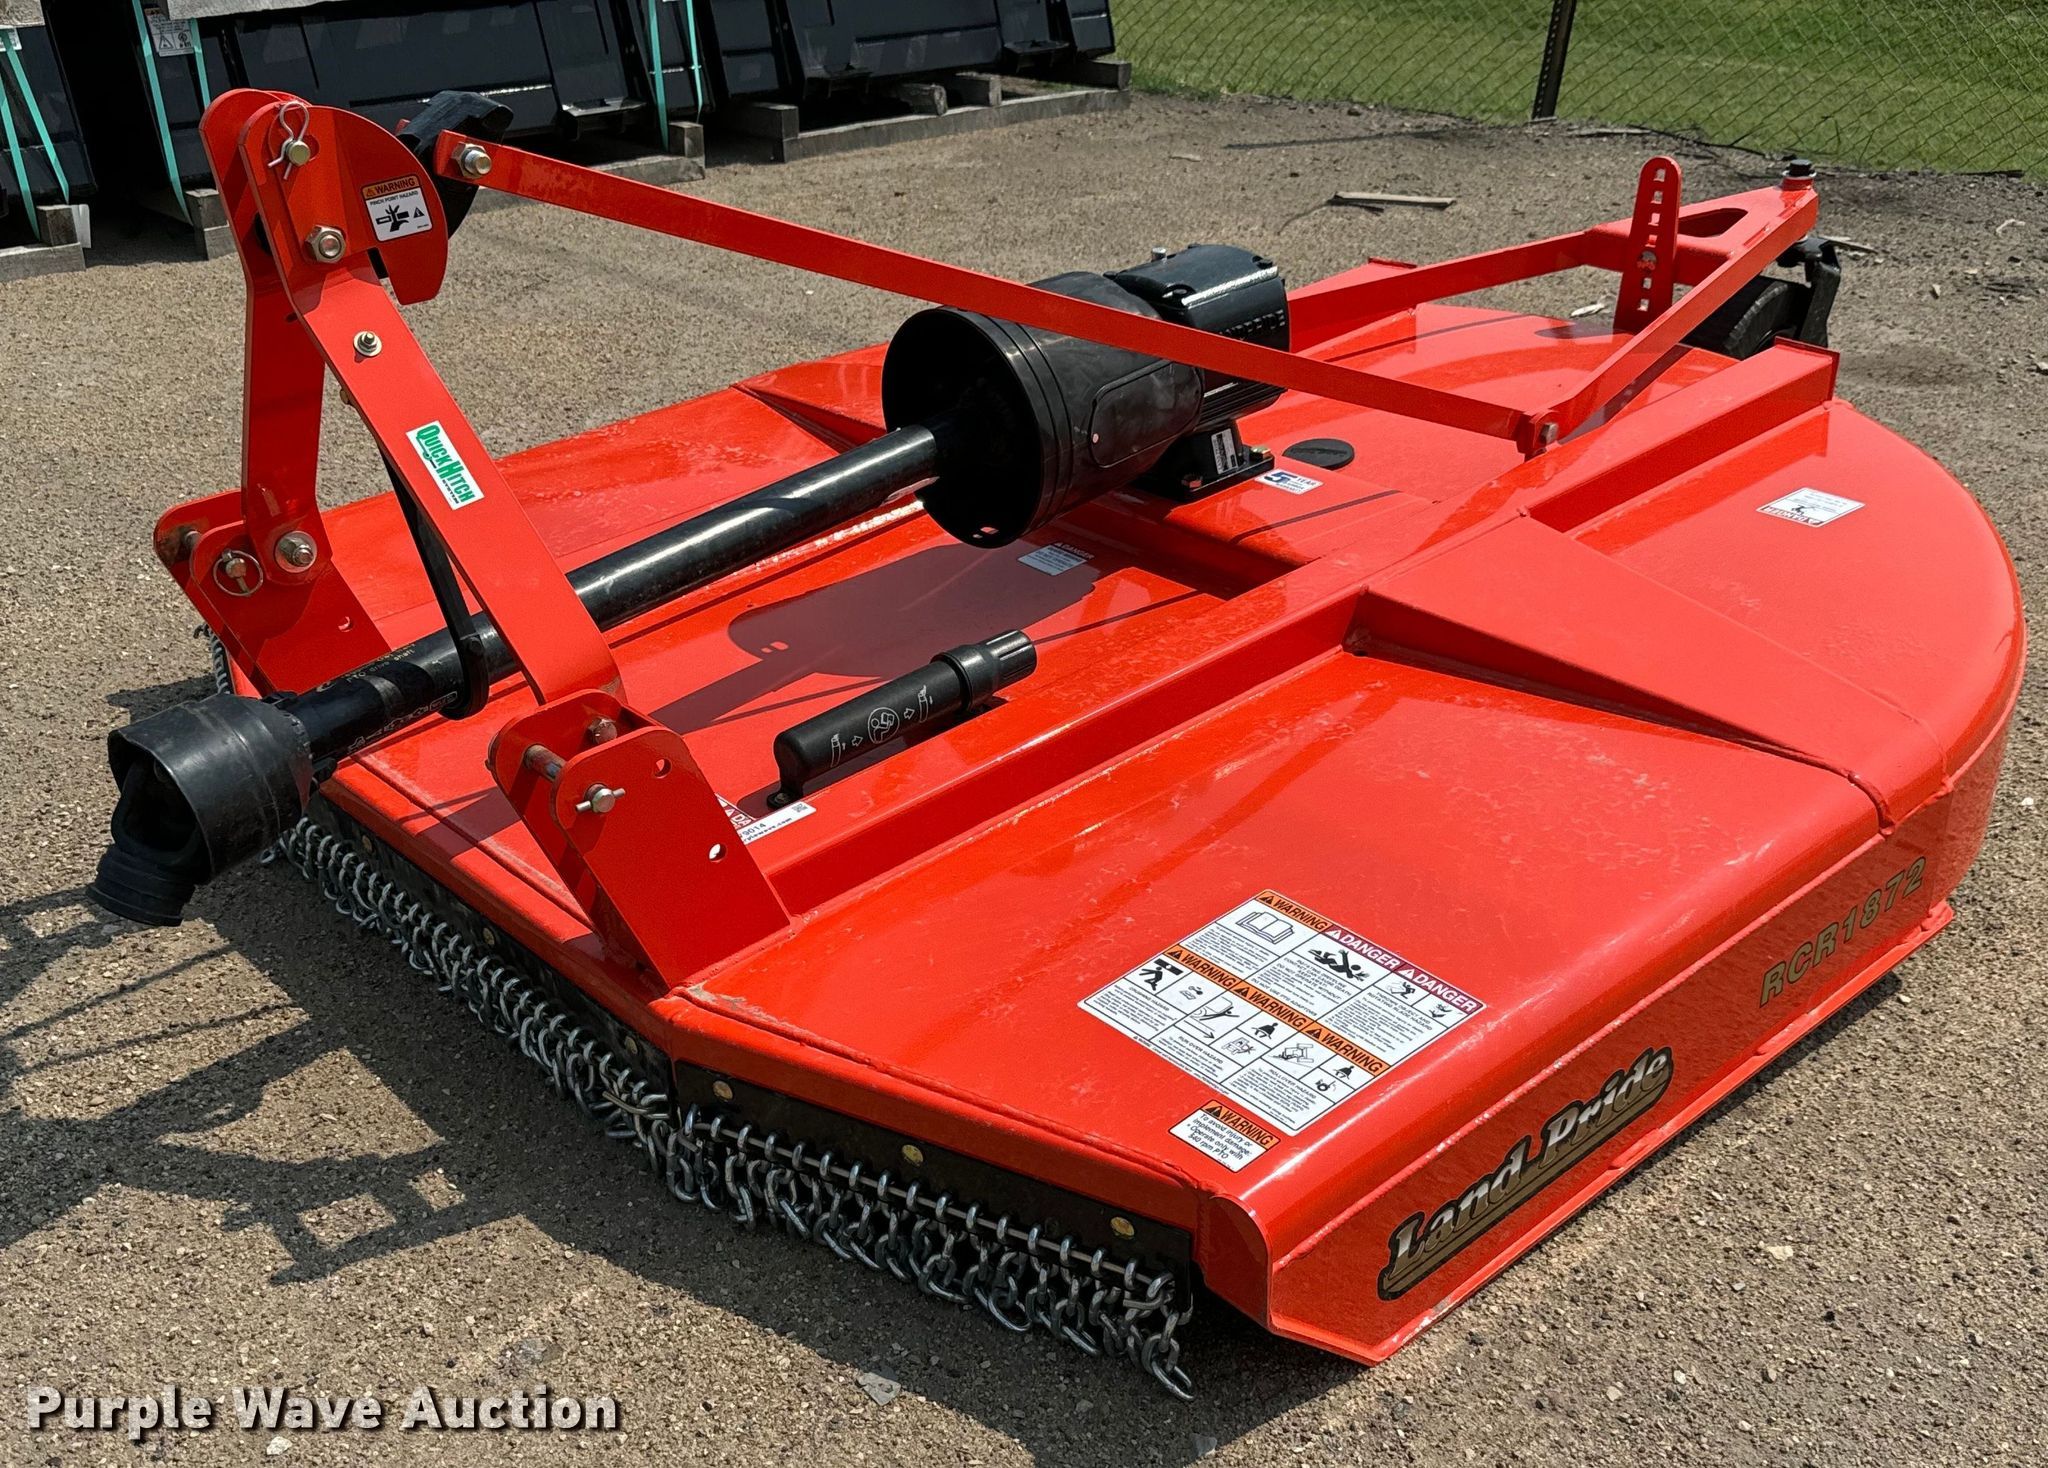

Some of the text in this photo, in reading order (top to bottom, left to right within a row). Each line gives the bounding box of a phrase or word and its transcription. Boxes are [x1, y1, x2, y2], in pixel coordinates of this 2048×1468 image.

[374, 177, 416, 195] WARNING
[1271, 899, 1329, 930] WARNING
[1759, 856, 1927, 1009] RCR1872
[1337, 934, 1401, 968] DANGER
[1179, 953, 1237, 987] WARNING
[1246, 991, 1308, 1027] WARNING
[1410, 973, 1479, 1011] DANGER
[1317, 1032, 1385, 1072] WARNING
[1188, 1124, 1245, 1160] Operate only with
[1198, 1113, 1210, 1121] To
[1207, 1118, 1227, 1131] avoid
[1224, 1129, 1245, 1142] injury
[1218, 1110, 1275, 1145] WARNING
[1187, 1132, 1230, 1159] 540 rpm PTO
[1386, 1047, 1673, 1281] Land Pride
